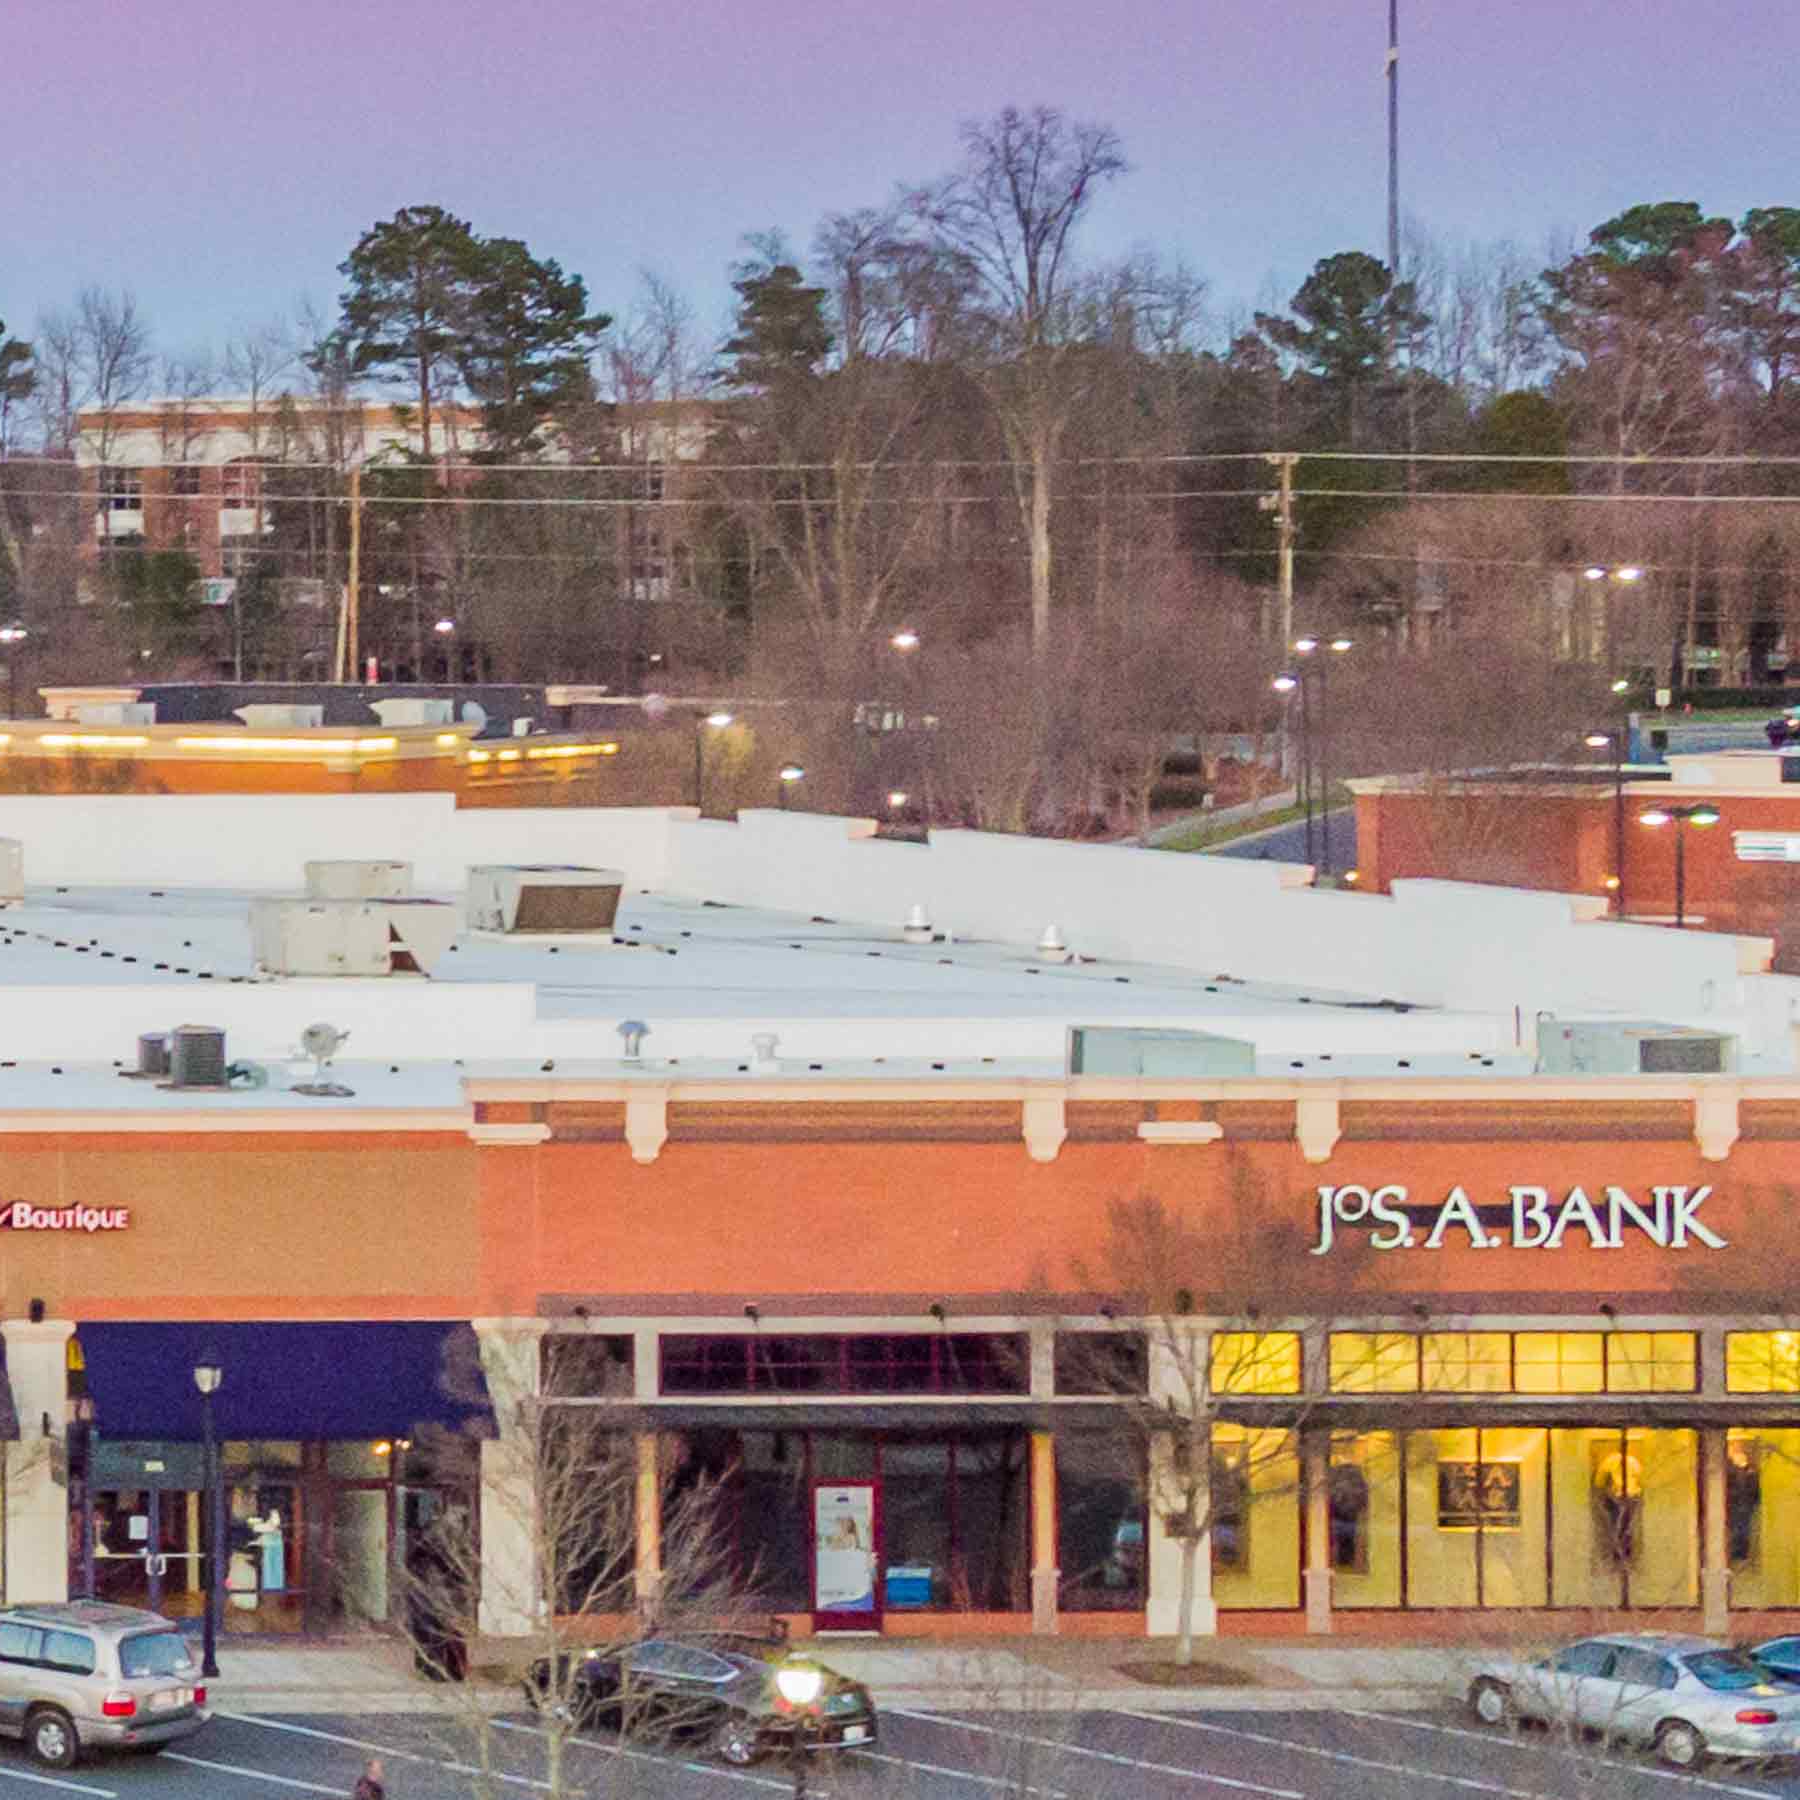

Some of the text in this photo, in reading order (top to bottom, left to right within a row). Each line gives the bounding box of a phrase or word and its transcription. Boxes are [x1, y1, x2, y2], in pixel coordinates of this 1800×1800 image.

[12, 1202, 129, 1232] BOUTIQUE
[1423, 1186, 1501, 1249] A.
[1509, 1185, 1729, 1249] BANK
